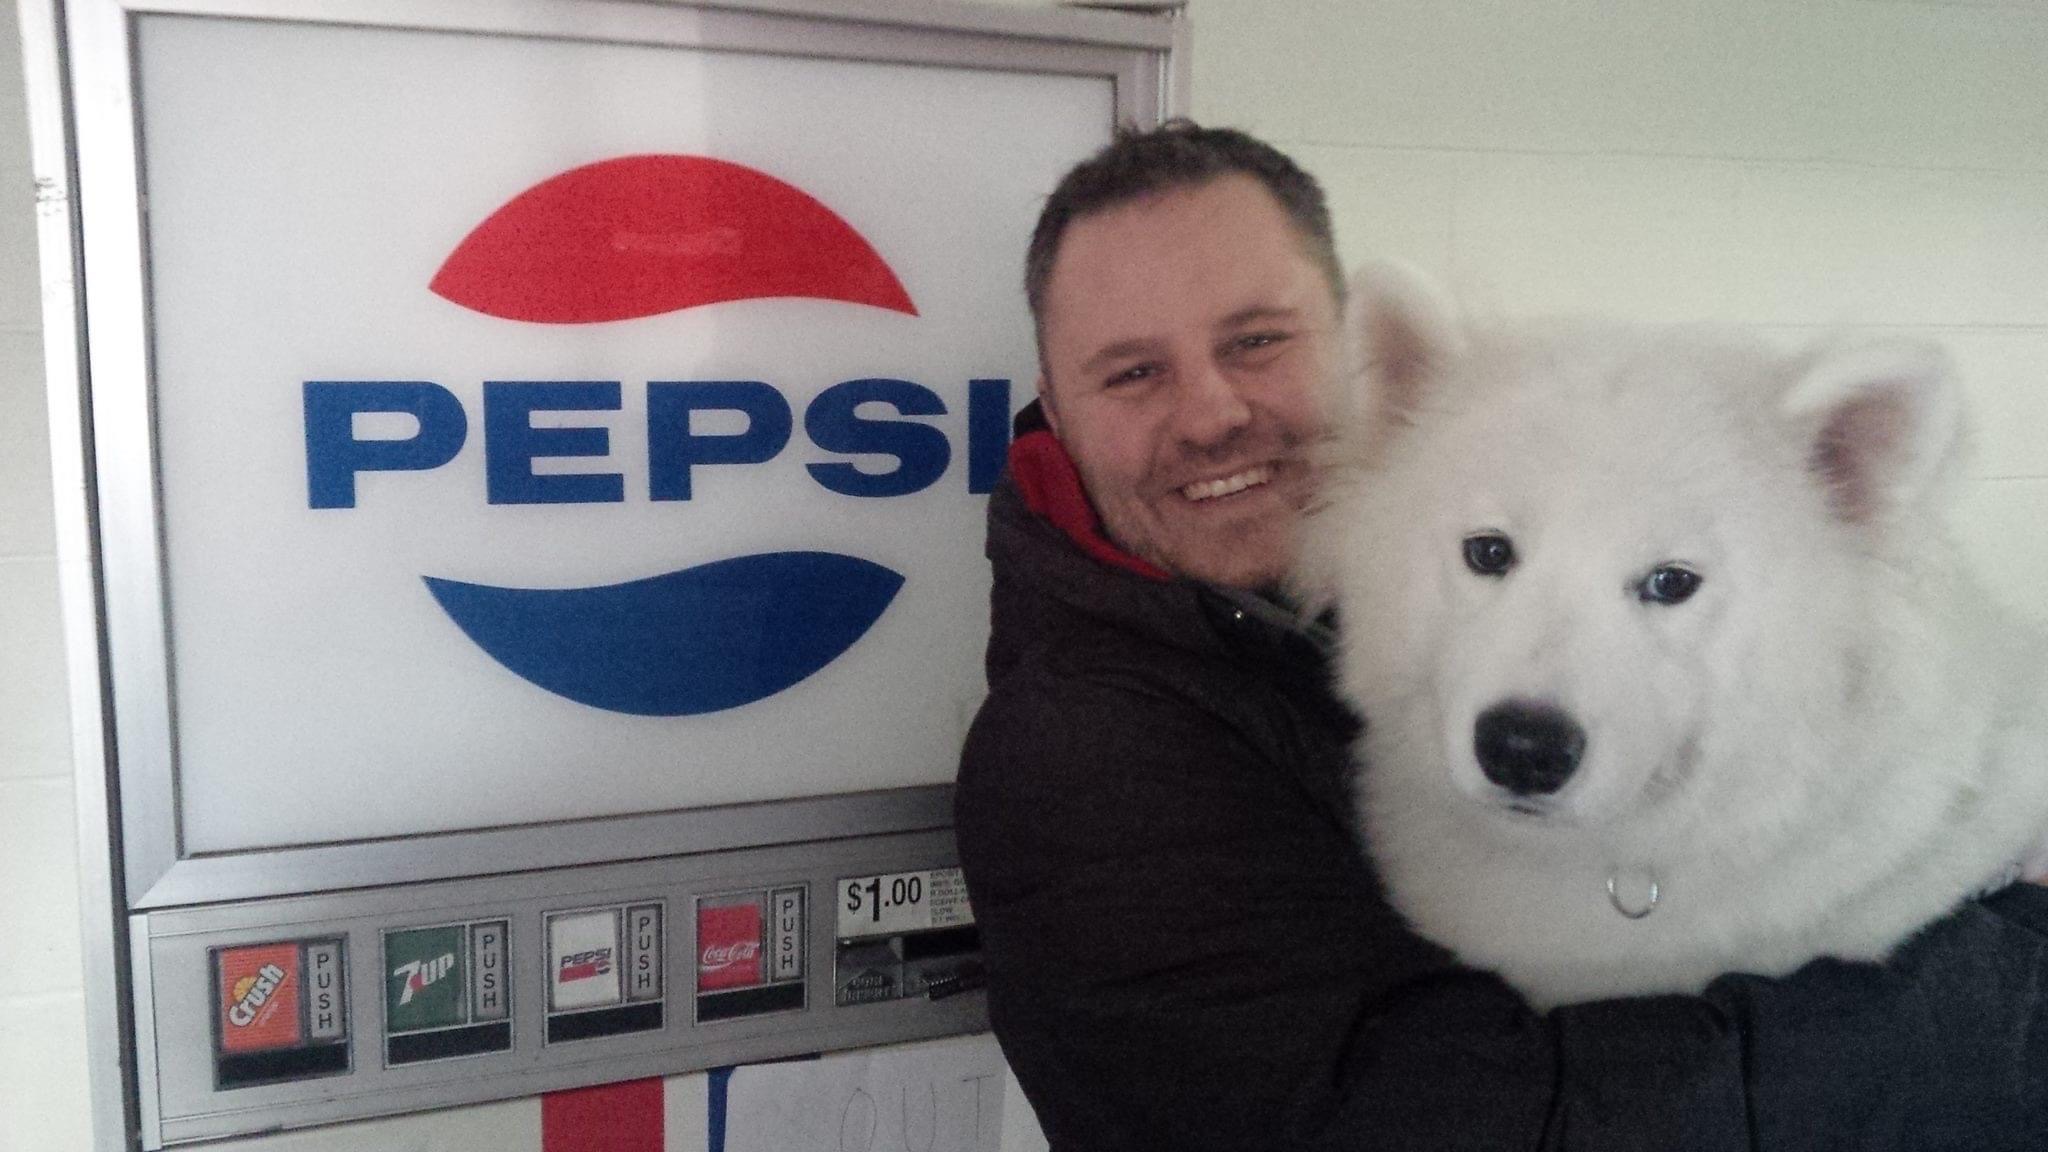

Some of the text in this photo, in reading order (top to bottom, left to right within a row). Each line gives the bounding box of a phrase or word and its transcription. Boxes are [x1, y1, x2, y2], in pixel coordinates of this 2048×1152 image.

[302, 378, 1011, 509] PEPSI
[782, 899, 793, 969] PUSH
[847, 876, 922, 922] $1.00
[482, 934, 497, 1008] PUSH
[560, 948, 611, 968] PEPSI
[638, 916, 650, 989] PUSH
[229, 963, 285, 1027] Crush
[317, 953, 333, 1029] PUSH
